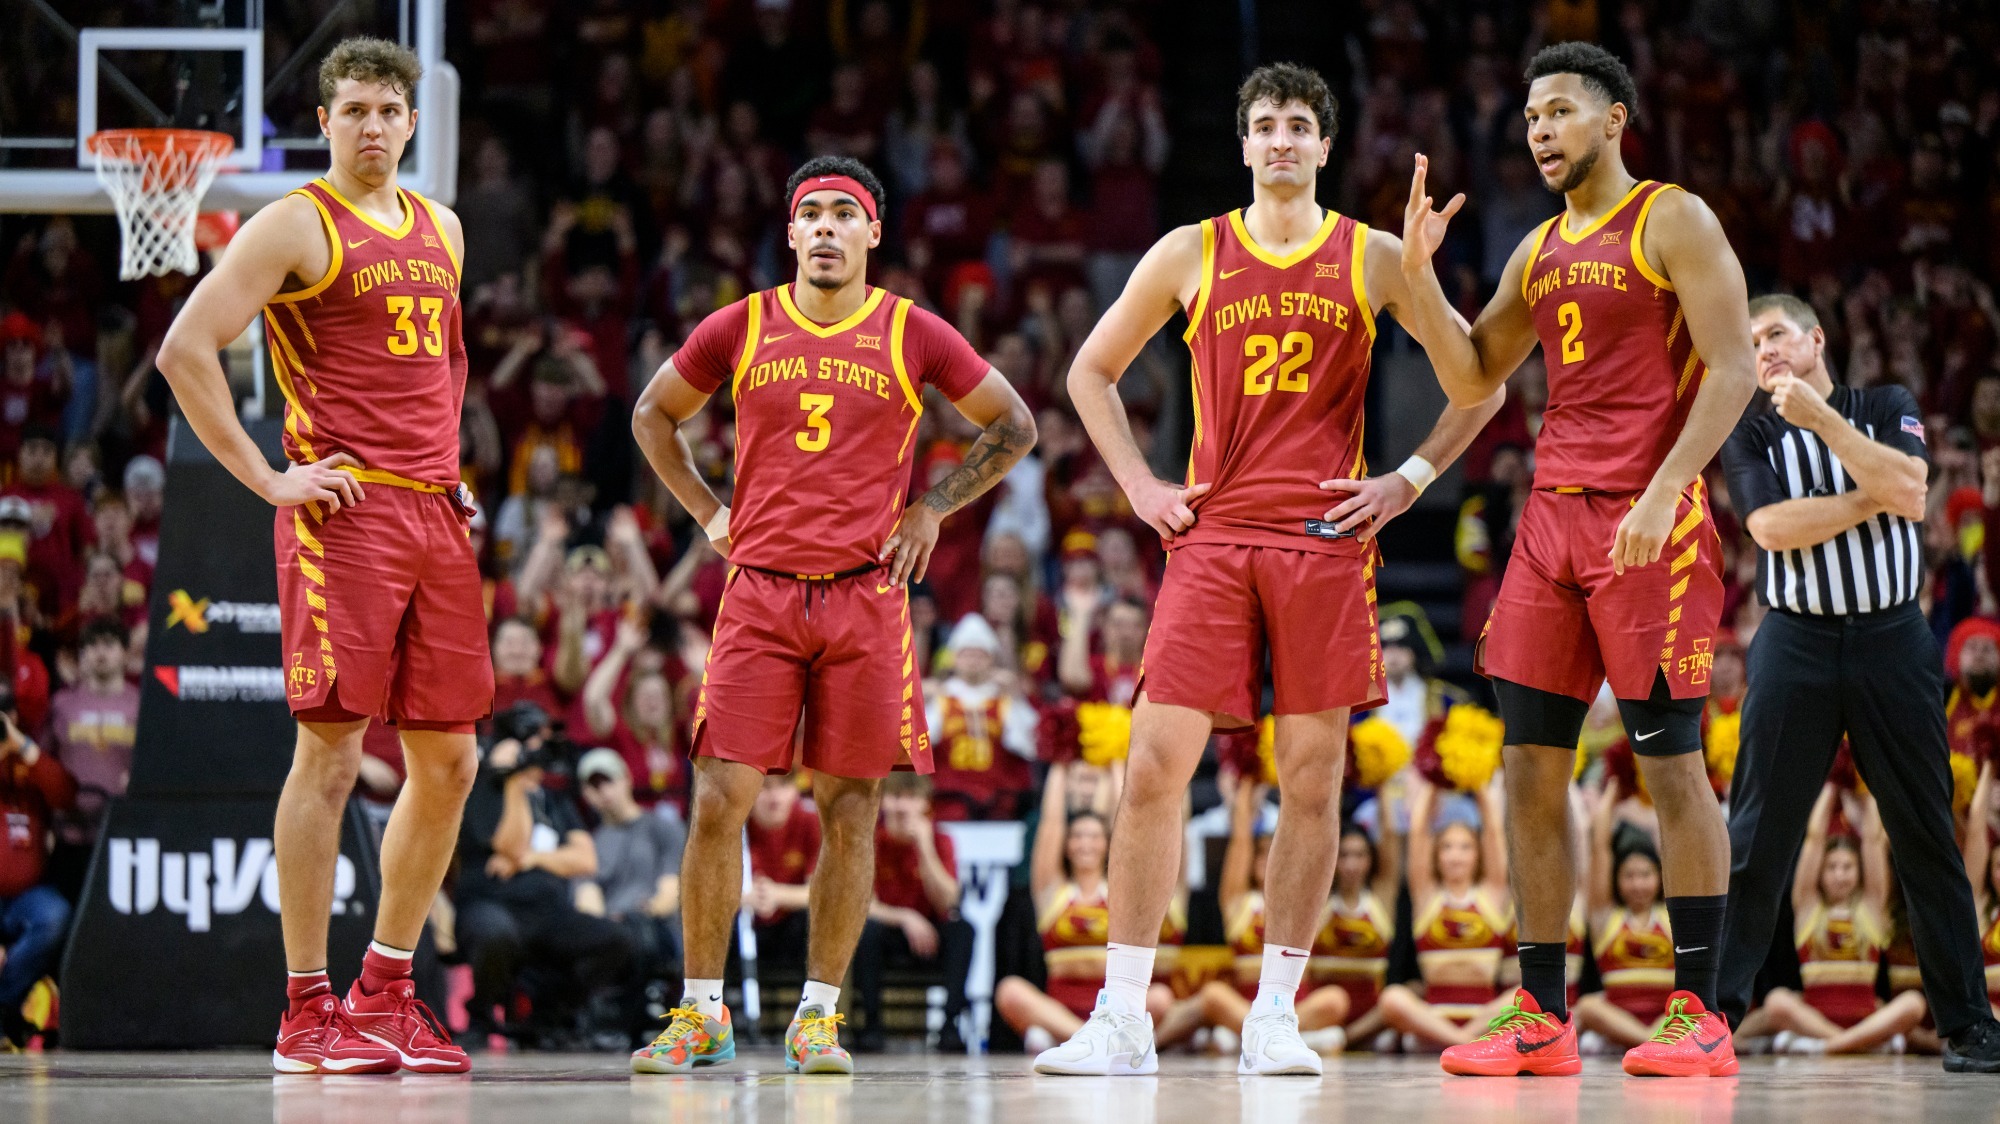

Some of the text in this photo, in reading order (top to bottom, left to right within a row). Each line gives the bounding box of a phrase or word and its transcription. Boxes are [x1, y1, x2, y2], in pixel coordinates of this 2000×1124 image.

[352, 258, 456, 299] IOWA STATE
[1528, 261, 1627, 311] IOWA STATE
[386, 295, 444, 357] 33
[1214, 291, 1349, 336] IOWA STATE
[1557, 301, 1585, 365] 2
[748, 356, 890, 400] IOWA STATE
[1243, 331, 1314, 396] 22
[795, 392, 835, 452] 3
